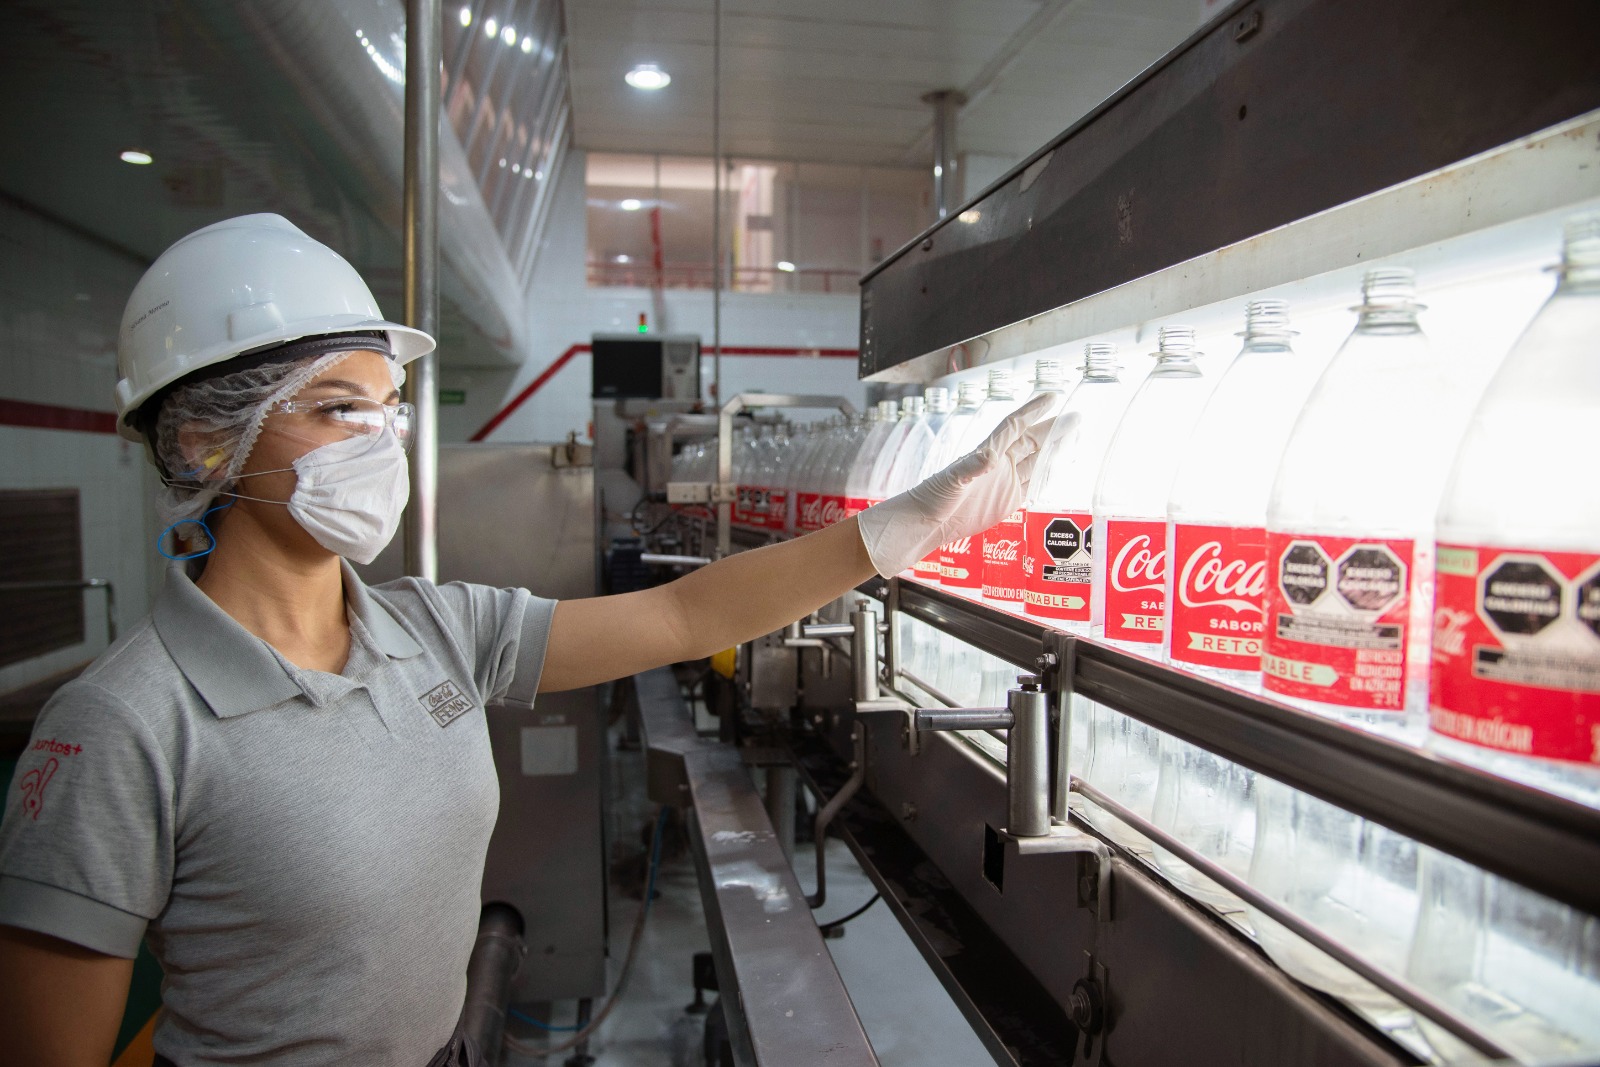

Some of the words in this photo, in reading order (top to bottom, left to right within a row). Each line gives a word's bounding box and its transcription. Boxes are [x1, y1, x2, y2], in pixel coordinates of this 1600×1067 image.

[1179, 541, 1265, 613] Coca
[1210, 618, 1263, 632] SABOR
[435, 699, 470, 723] FEMSA
